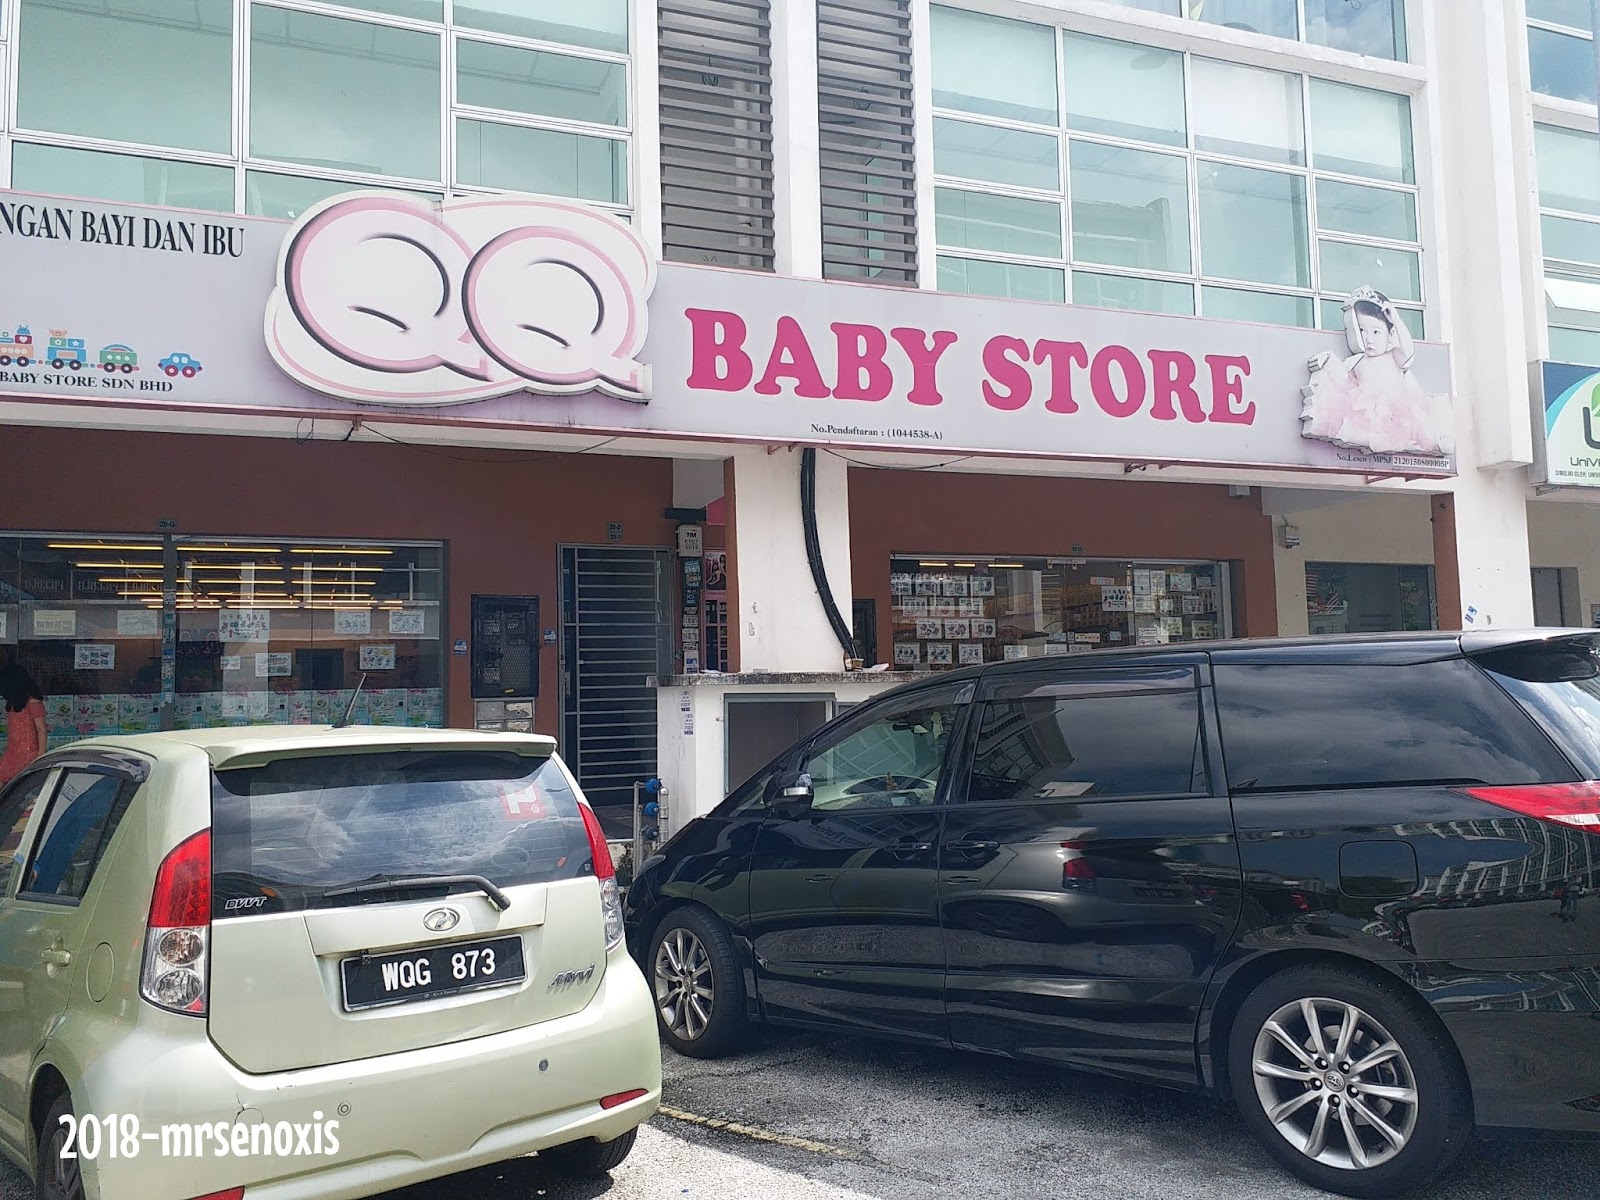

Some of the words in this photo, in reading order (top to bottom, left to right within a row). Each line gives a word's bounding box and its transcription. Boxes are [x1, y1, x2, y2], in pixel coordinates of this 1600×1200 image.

[0, 202, 74, 241] NGAN
[80, 210, 136, 248] BAYI
[142, 217, 196, 254] DAN
[202, 224, 245, 258] IBU
[285, 196, 643, 393] QQ
[0, 371, 39, 384] BABY
[43, 373, 98, 388] STORE
[101, 377, 135, 390] SDN
[139, 379, 173, 393] BHD
[684, 307, 958, 407] BABY
[981, 334, 1257, 426] STORE
[810, 423, 879, 437] No.Pendaftaran
[887, 428, 943, 441] (1044538-A)
[224, 896, 268, 910] DVVT
[380, 957, 432, 992] WQG
[451, 947, 497, 979] 873
